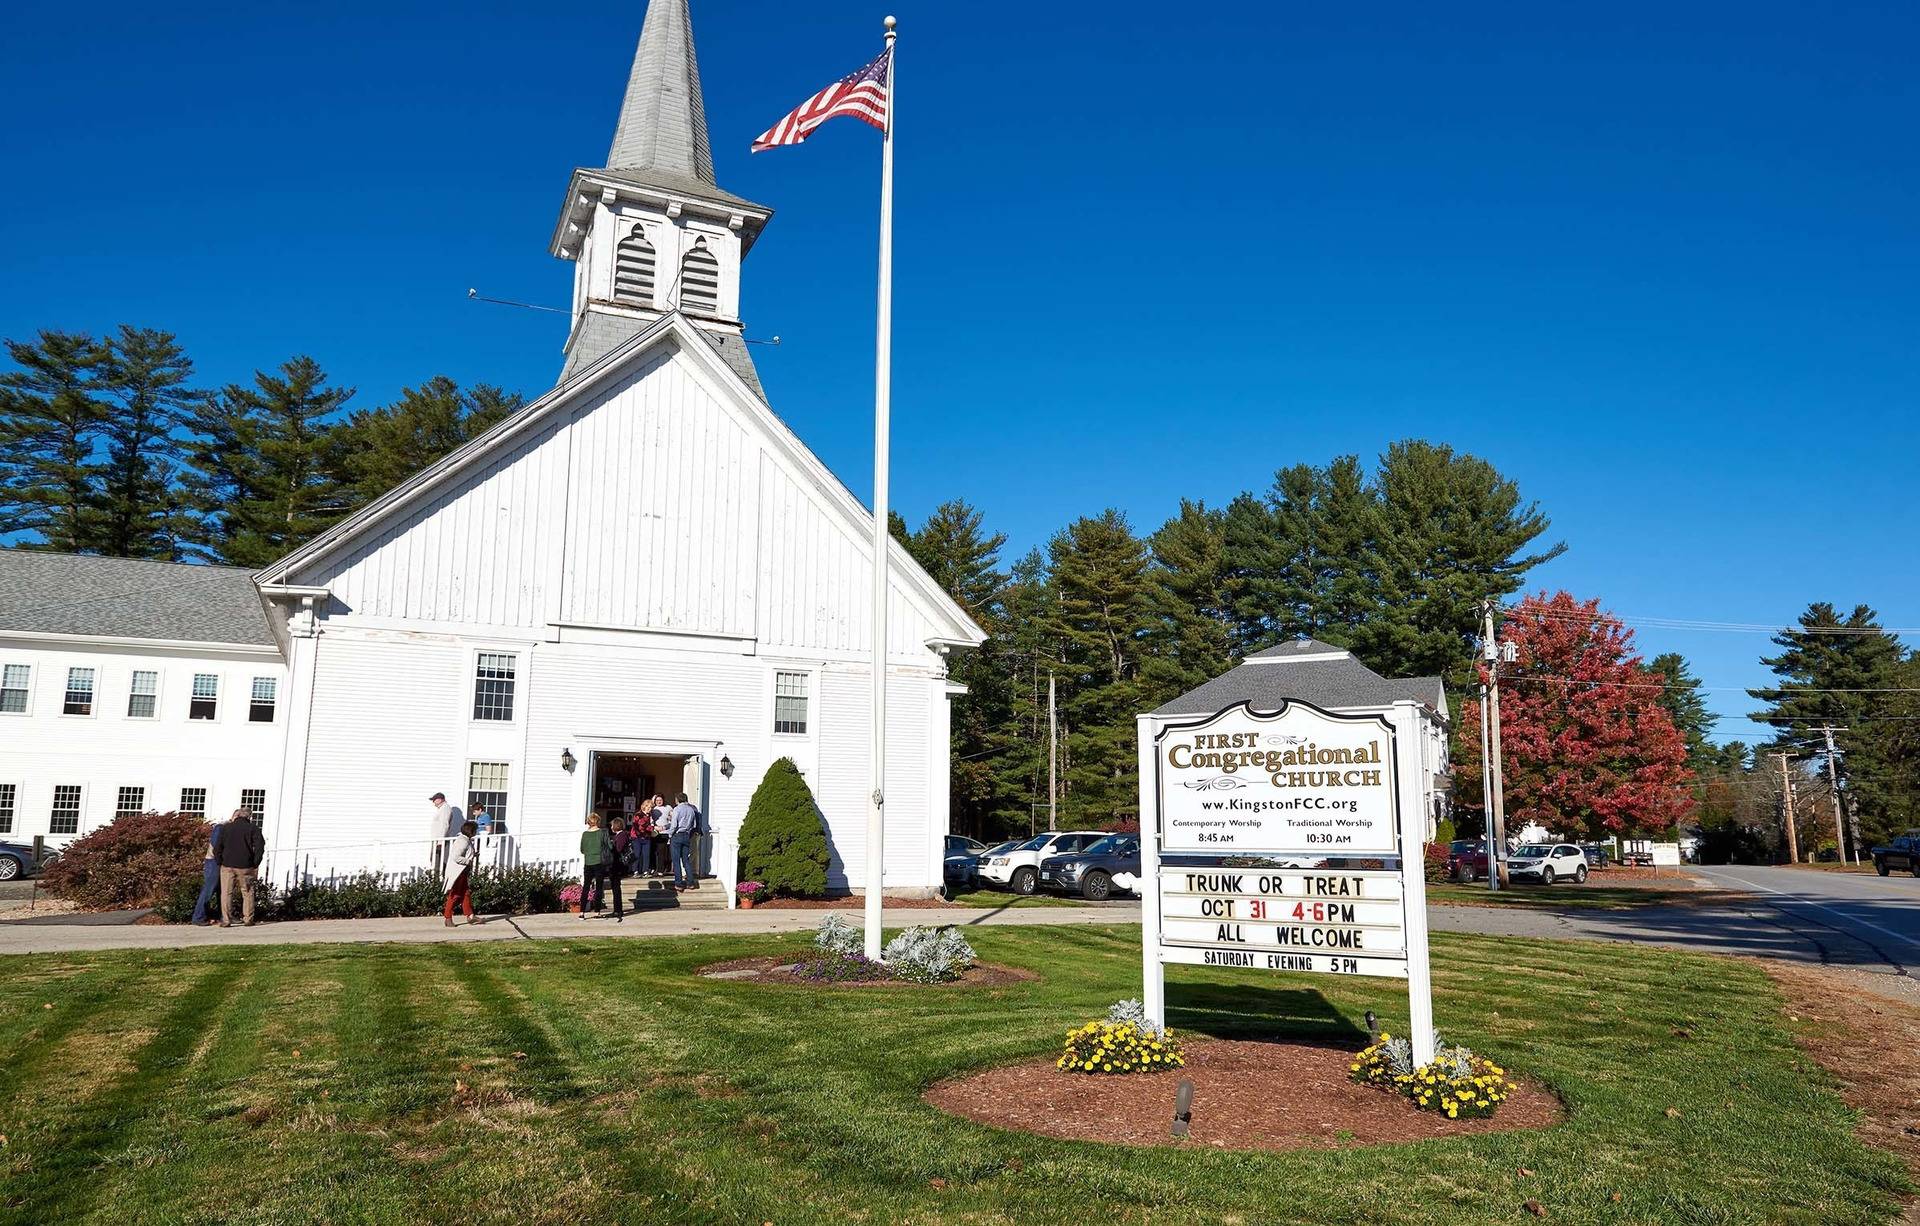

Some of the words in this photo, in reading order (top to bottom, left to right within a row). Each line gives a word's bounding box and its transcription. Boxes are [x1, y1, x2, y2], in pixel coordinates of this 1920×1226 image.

[1194, 732, 1259, 750] FIRST
[1168, 740, 1381, 774] Congregational
[1271, 769, 1382, 788] CHURCH
[1172, 819, 1226, 828] Contemporary
[1229, 819, 1262, 828] Worship
[1287, 819, 1332, 827] Traditional
[1335, 819, 1373, 828] Worship
[1198, 833, 1218, 843] 8:45
[1306, 833, 1332, 843] 10:30
[1335, 835, 1351, 843] AM
[1186, 874, 1243, 893] TRUNK
[1259, 876, 1283, 894] OR
[1303, 876, 1364, 896] TREAT
[1201, 899, 1235, 917] OCT
[1250, 900, 1266, 919] 31
[1217, 924, 1245, 942] ALL
[1276, 927, 1363, 948] WELCOME
[1204, 951, 1254, 967] SATURDAY
[1267, 955, 1312, 970] EVENING
[1330, 960, 1339, 972] 5
[1343, 960, 1357, 973] PM
